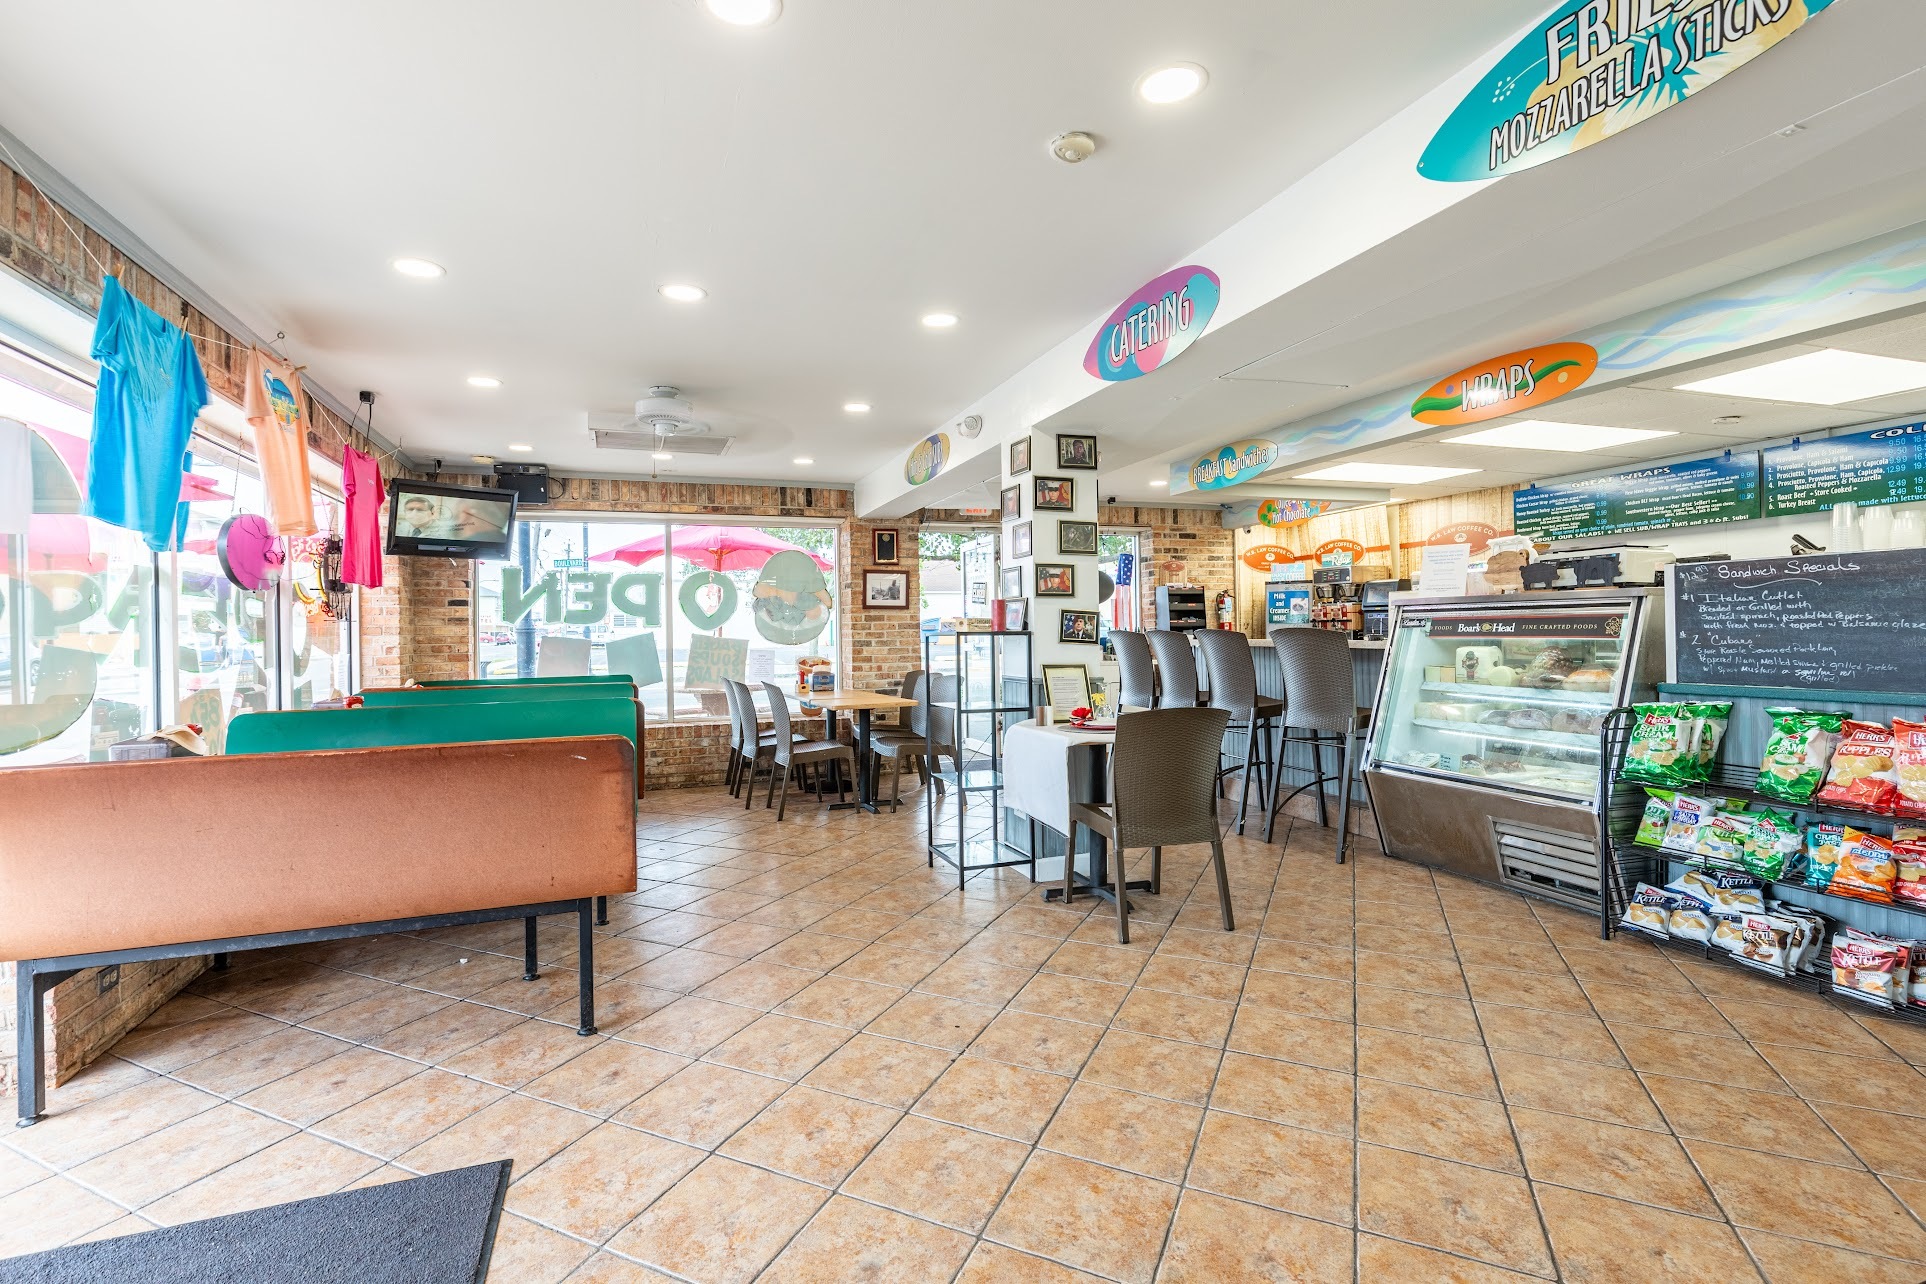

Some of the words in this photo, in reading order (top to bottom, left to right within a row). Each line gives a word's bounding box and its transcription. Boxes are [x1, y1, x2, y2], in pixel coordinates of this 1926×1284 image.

[1546, 0, 1688, 85] FRIE
[1487, 35, 1664, 171] MOZZARELLA
[1672, 0, 1793, 74] STICKS
[1110, 285, 1191, 363] CATERING
[1461, 359, 1536, 412] WRAPS
[1888, 438, 1906, 446] 9.50
[1913, 434, 1926, 443] 16.
[1807, 457, 1832, 469] Capicola
[1839, 454, 1854, 464] Ham
[1913, 444, 1926, 452] 16.
[1839, 462, 1854, 471] Ham
[1862, 457, 1889, 469] Capicola
[1913, 453, 1926, 461] 16.
[1193, 458, 1227, 484] BREAKFAST
[1228, 447, 1269, 474] Sandwiches
[1886, 464, 1907, 474] 12.99
[1913, 462, 1926, 470] 19.
[1620, 466, 1671, 481] WRAPS
[1740, 471, 1754, 479] 9.99
[1794, 482, 1816, 491] Roasted
[1817, 479, 1840, 489] Peppers
[1841, 477, 1847, 485] &
[1848, 474, 1882, 485] Mozzarella
[1777, 491, 1792, 500] Roast
[1793, 489, 1807, 499] Beef
[1814, 487, 1829, 497] Store
[1830, 484, 1853, 495] Cooked
[1777, 501, 1798, 510] Turkey
[1799, 498, 1816, 507] Breast
[1858, 497, 1878, 506] made
[1880, 494, 1898, 504] with
[1283, 508, 1311, 521] Chocolate
[1443, 527, 1456, 535] LAW
[1636, 523, 1669, 531] SUB/WRAP
[1334, 541, 1353, 549] COFFEE
[1267, 547, 1286, 556] COFFEE
[1718, 565, 1777, 578] Sandwich
[1784, 556, 1861, 574] Specials
[1273, 592, 1286, 600] Milk
[1762, 590, 1803, 601] Cutlet
[1786, 601, 1811, 609] with
[1457, 622, 1480, 633] Boar's
[1491, 622, 1516, 633] Head
[1891, 618, 1926, 632] glaze
[1840, 745, 1892, 757] RIPPLES
[1720, 877, 1754, 889] KETTLE
[1635, 894, 1667, 904] KETTLE
